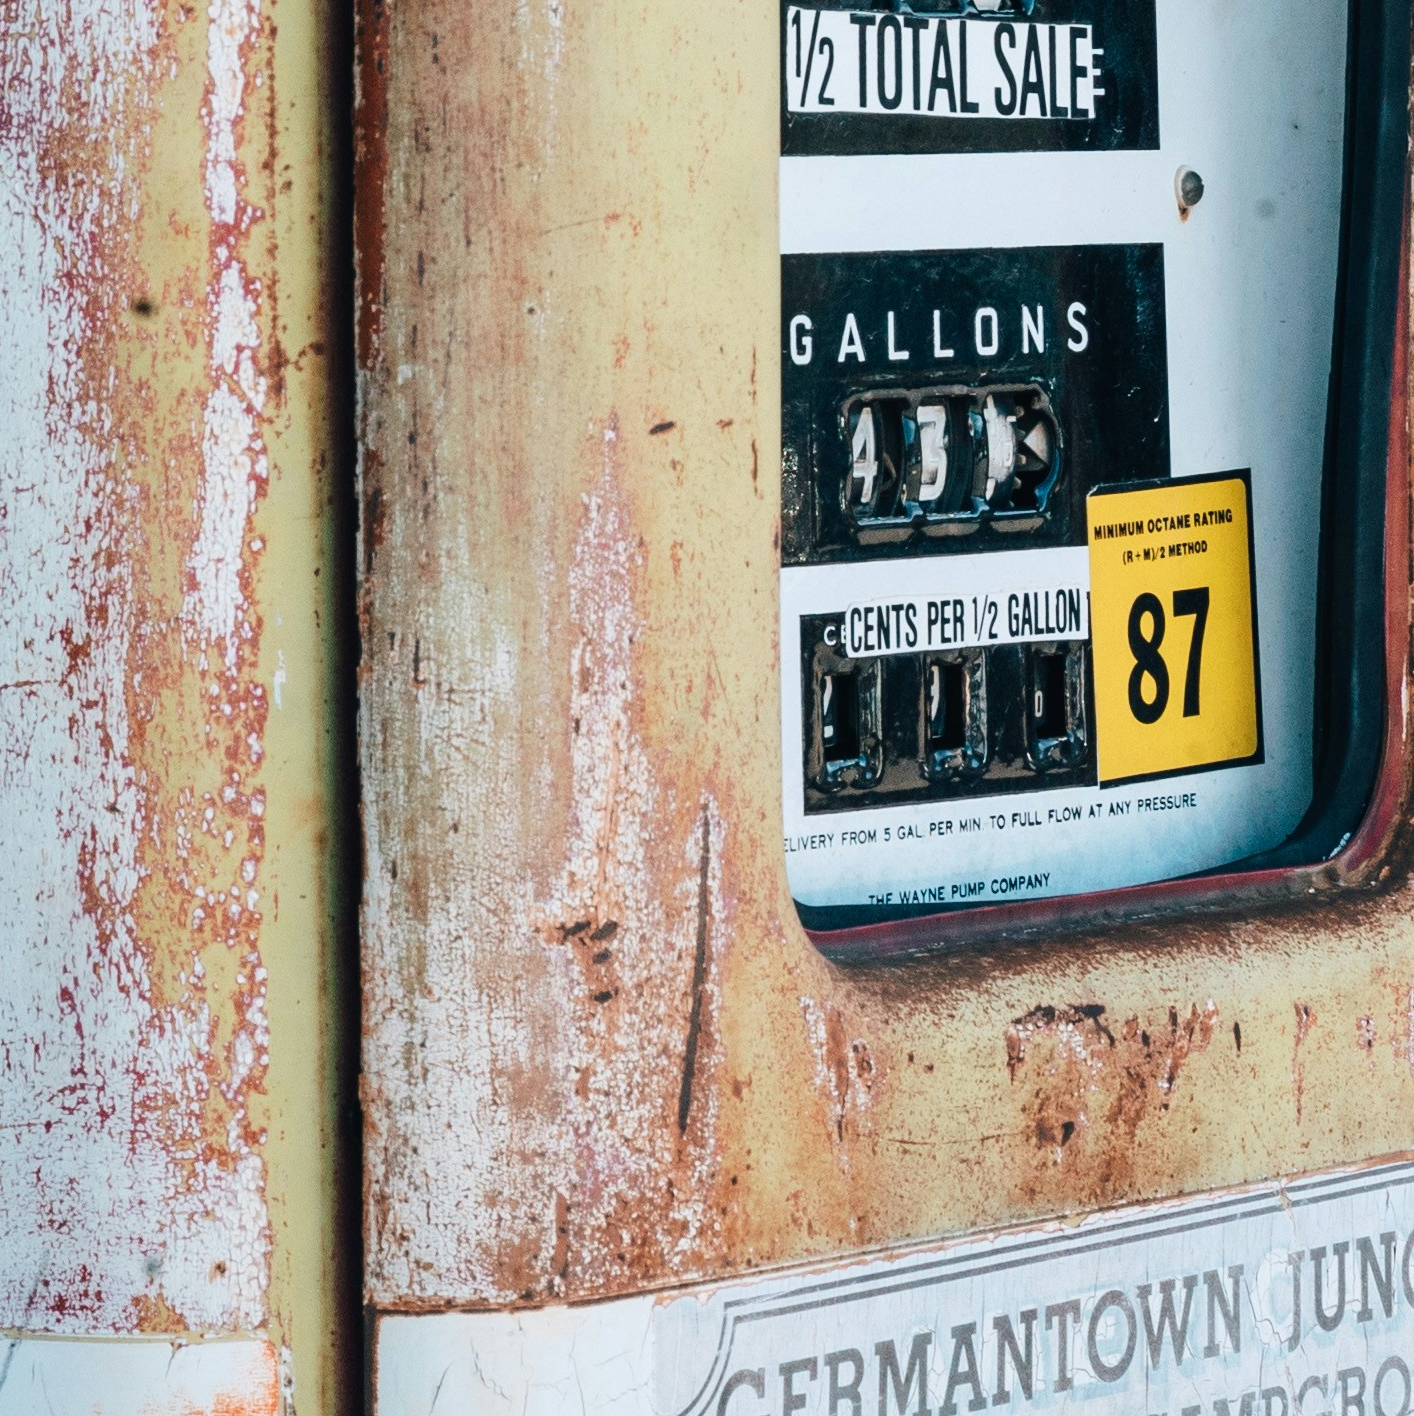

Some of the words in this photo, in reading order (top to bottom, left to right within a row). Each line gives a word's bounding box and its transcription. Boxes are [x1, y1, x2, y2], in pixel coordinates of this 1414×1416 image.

[791, 9, 835, 108] 1/2
[850, 13, 980, 114] TOTAL
[993, 22, 1089, 119] SALE
[789, 301, 1089, 366] GALLONS
[1094, 520, 1144, 541] MINIMUM
[1147, 514, 1191, 534] OCTANE
[1193, 508, 1233, 528] RATING
[1168, 540, 1208, 558] METHOD
[850, 602, 918, 654] CENTS
[927, 598, 965, 646] PER
[972, 594, 998, 643] 1/2
[1007, 588, 1081, 639] GALLON
[1127, 586, 1210, 726] 87
[841, 829, 877, 847] FROM
[883, 827, 891, 842] 5
[929, 820, 954, 836] PER
[989, 814, 1006, 830] TO
[1011, 810, 1042, 828] FULL
[1048, 806, 1083, 823] FLOW
[1088, 803, 1103, 819] AT
[1108, 800, 1132, 817] ANY
[1137, 792, 1197, 813] PRESSURE
[899, 886, 945, 904] WAYNE
[951, 881, 986, 899] PUMP
[990, 872, 1051, 895] COMPANY
